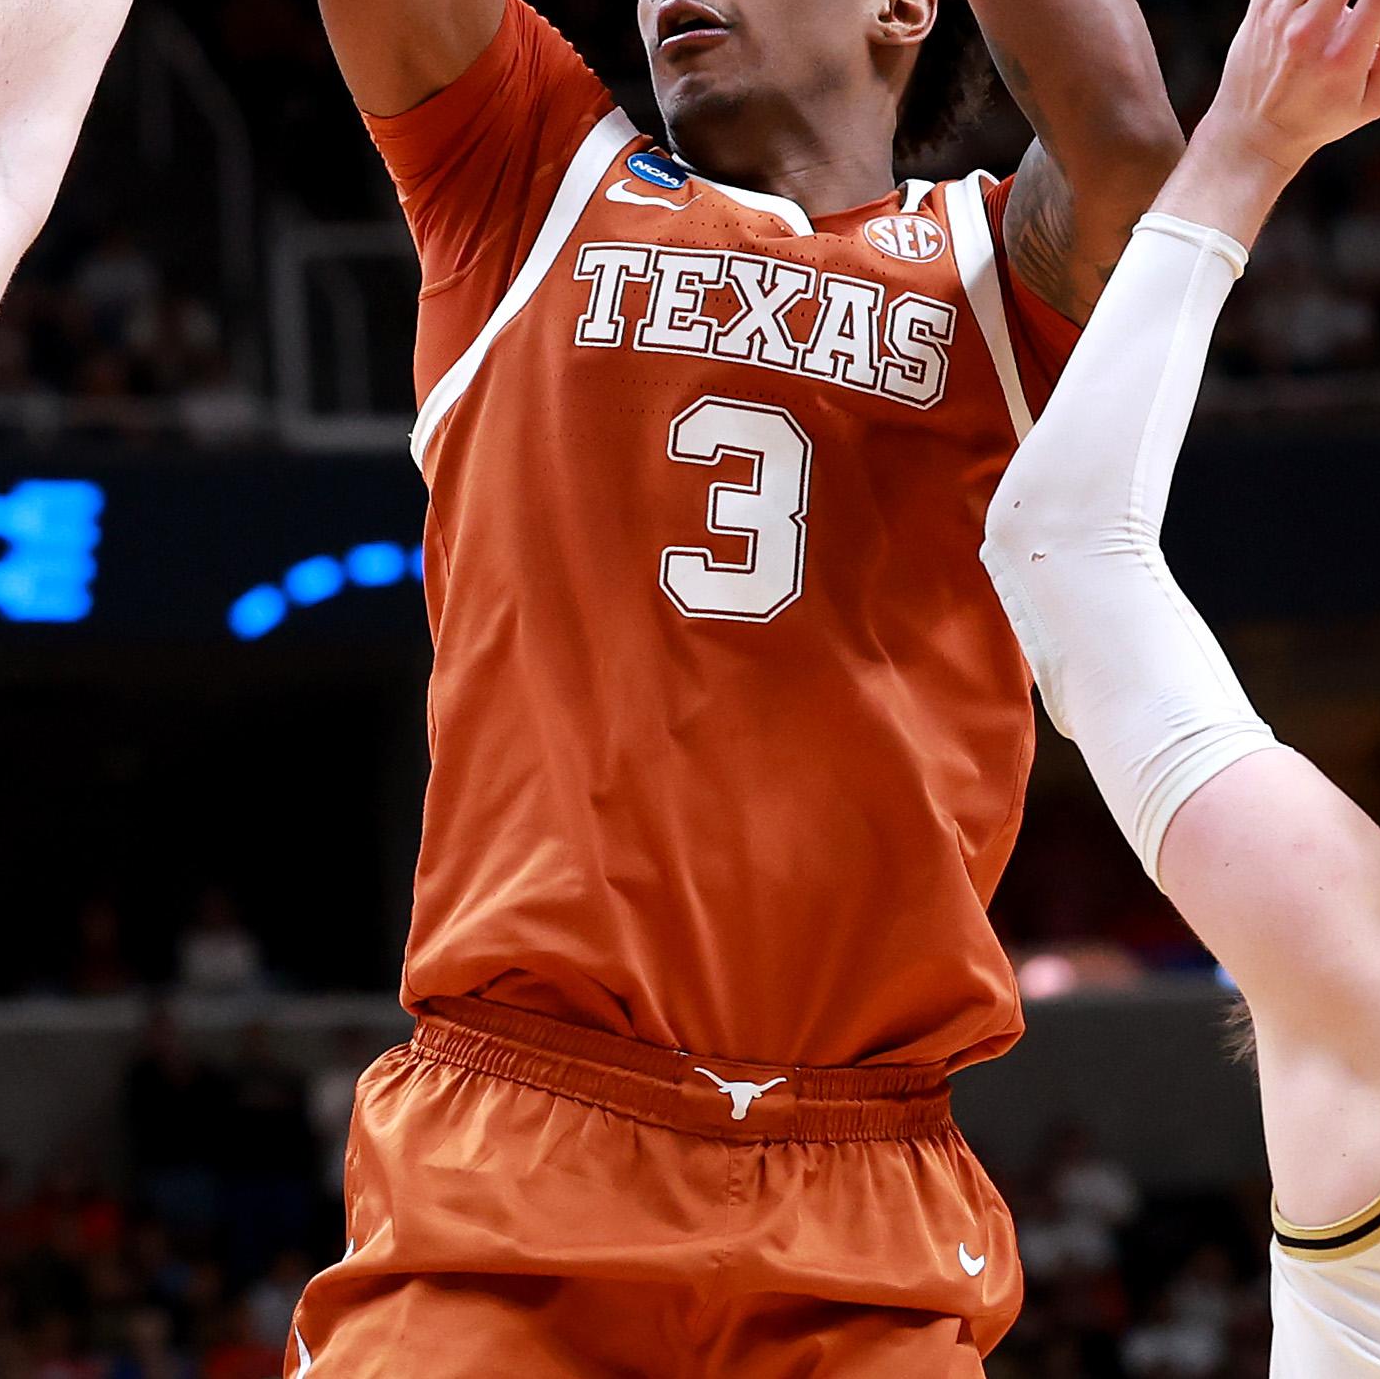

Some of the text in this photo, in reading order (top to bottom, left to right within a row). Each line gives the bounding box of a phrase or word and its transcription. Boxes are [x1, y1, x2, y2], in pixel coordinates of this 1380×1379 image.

[632, 160, 680, 187] NCAA
[871, 217, 939, 259] SEC
[574, 242, 956, 410] TEXAS
[659, 395, 813, 624] 3
